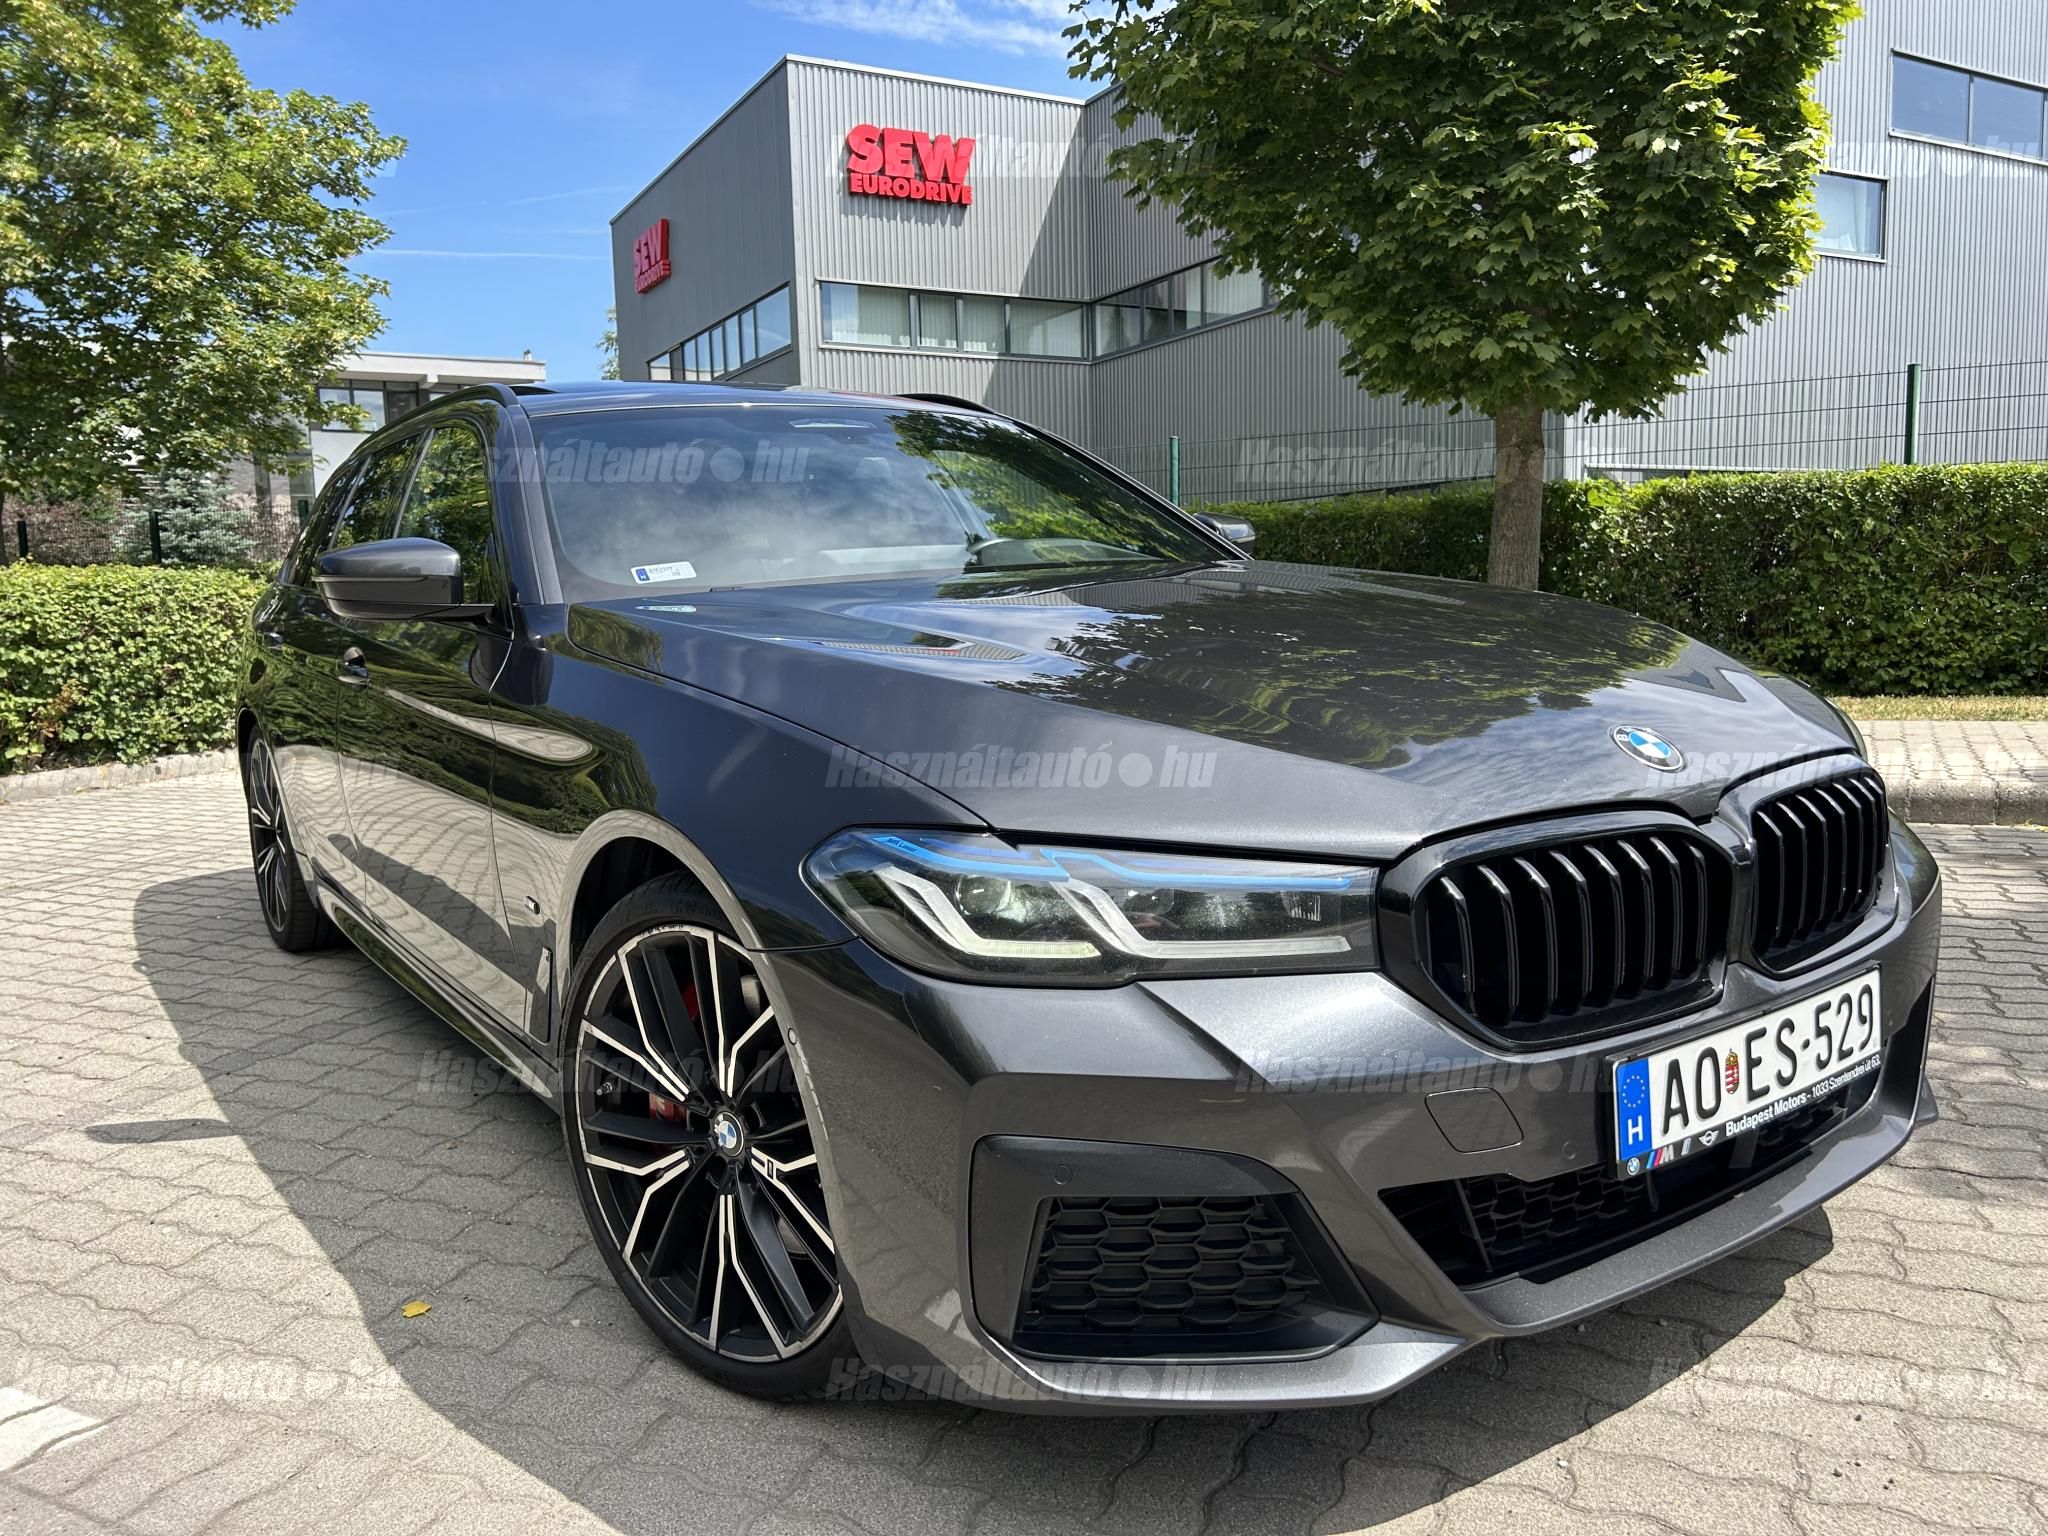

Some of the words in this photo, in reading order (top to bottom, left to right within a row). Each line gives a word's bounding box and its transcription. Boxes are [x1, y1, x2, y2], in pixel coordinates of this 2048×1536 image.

[847, 124, 976, 184] SEW
[850, 172, 972, 206] EURODRIVE
[634, 218, 669, 277] SEW
[1661, 1046, 1722, 1135] AO
[1725, 1105, 1773, 1137] Budapest
[1774, 1091, 1807, 1116] Motors
[1811, 1083, 1829, 1098] 1033
[1829, 1063, 1865, 1092] Szentendrei
[1628, 1115, 1643, 1145] H
